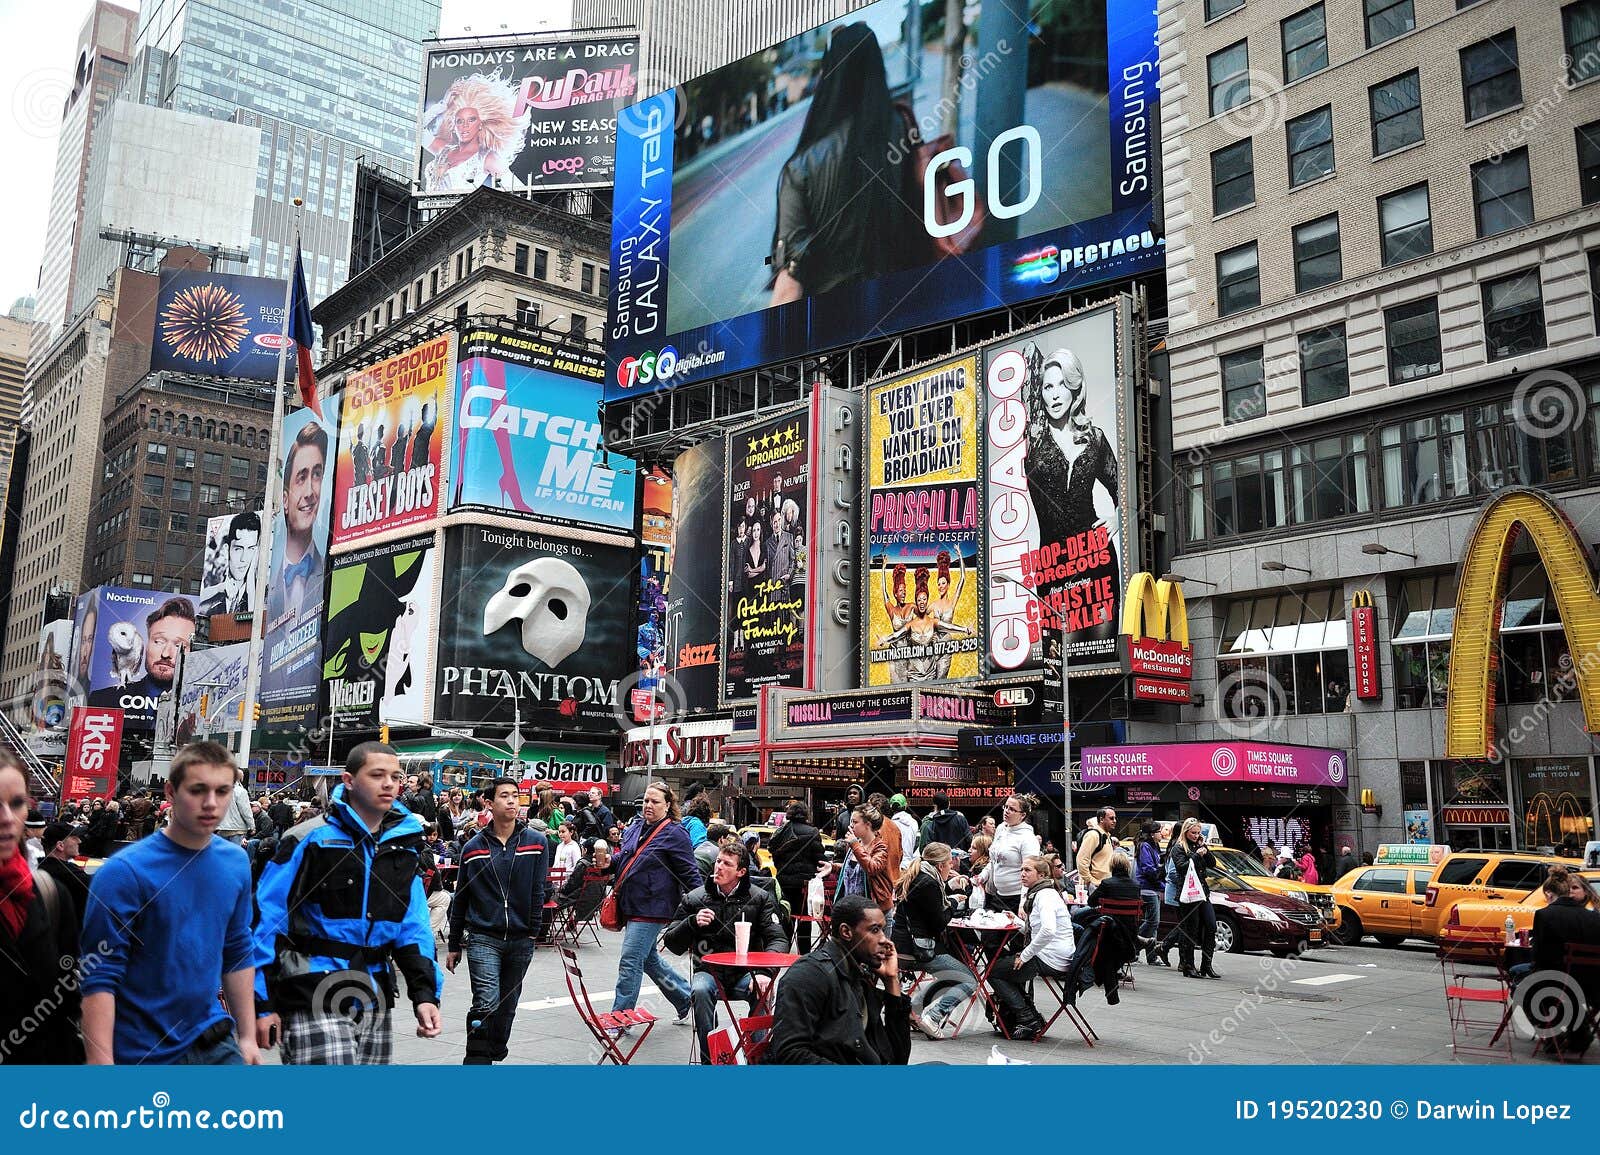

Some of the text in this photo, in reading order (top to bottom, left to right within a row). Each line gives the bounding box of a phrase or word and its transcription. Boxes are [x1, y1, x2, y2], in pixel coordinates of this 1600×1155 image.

[431, 42, 635, 69] MONDAYS ARE A DRAG
[570, 86, 635, 106] DRAG RACE
[530, 120, 566, 135] NEW
[1119, 61, 1153, 196] Samsung
[530, 135, 599, 148] MON JAN 24
[640, 107, 666, 190] Tab
[923, 124, 1043, 238] GO
[612, 195, 664, 340] Samsung GALAXY
[386, 339, 448, 378] CROWD
[462, 331, 599, 365] A NEW MUSICAL from the
[490, 346, 532, 364] brought
[533, 356, 551, 368] you
[351, 379, 394, 410] GOES
[459, 384, 603, 452] CATCH
[888, 395, 954, 436] YOU EVER
[882, 416, 962, 461] WANTED ON
[538, 445, 617, 497] ME
[341, 462, 435, 531] JERSEY BOYS
[534, 485, 625, 512] IF YOU CAN
[870, 486, 978, 534] PRISCILLA
[987, 349, 1031, 670] CHICAGO
[480, 529, 524, 550] Tonight
[526, 538, 569, 556] belongs
[870, 530, 977, 544] QUEEN OF THE DESERT
[1020, 526, 1109, 576] DROP-DEAD
[1022, 549, 1111, 590] GORGEOUS
[106, 591, 156, 607] Nocturnal.
[754, 578, 784, 598] The
[1025, 575, 1114, 622] CHRISTIE
[736, 594, 803, 619] Addams
[741, 616, 799, 646] Family
[678, 642, 718, 668] starz
[871, 646, 925, 663] TICKETMASTER.COM
[933, 638, 978, 654] 877-250-2929
[1133, 647, 1191, 666] McDonald's
[1358, 612, 1370, 694] OPEN 24 HOURS
[1142, 662, 1182, 674] Restaurant
[440, 666, 621, 706] PHANTOM
[999, 689, 1029, 705] FUEL
[1139, 684, 1158, 693] OPEN
[735, 708, 758, 718] DESERT
[788, 696, 910, 724] PRISCILLA QUEEN OF THE DESERT
[919, 694, 976, 721] PRISCILLA
[79, 713, 115, 770] tkts
[974, 734, 993, 747] THE
[994, 733, 1037, 746] CHANGE
[534, 756, 604, 784] sbarro
[1085, 752, 1148, 764] TIMES SQUARE
[1085, 764, 1154, 776] VISITOR CENTER
[1247, 750, 1294, 764] TIMES SQUARE
[1247, 763, 1298, 777] VISITOR CENTER
[1535, 764, 1570, 772] BREAKFAST
